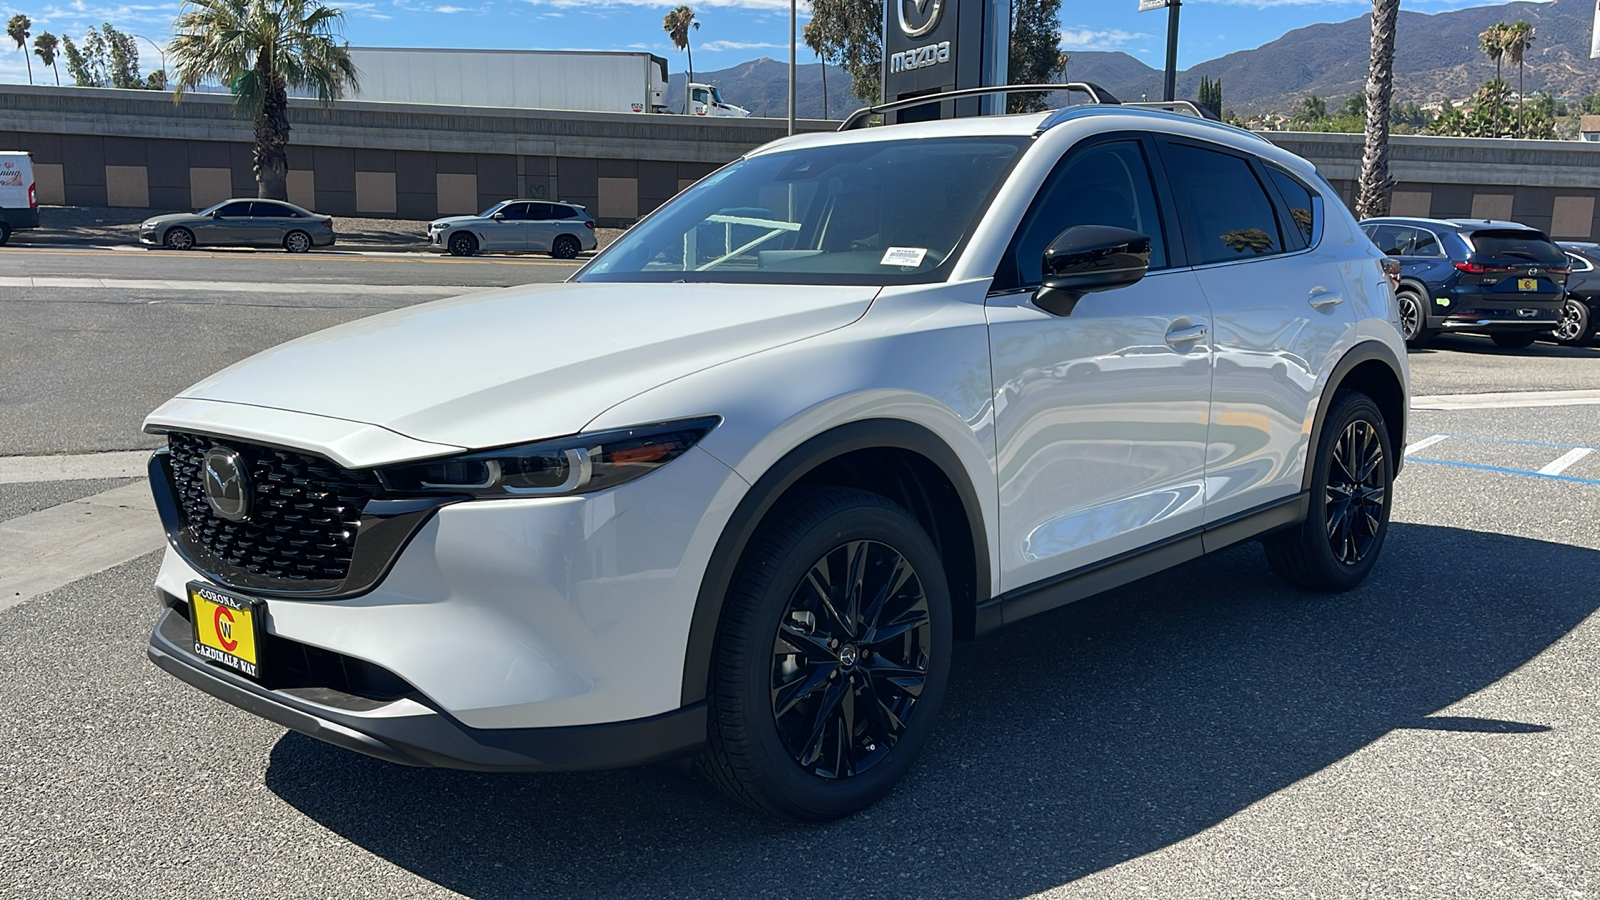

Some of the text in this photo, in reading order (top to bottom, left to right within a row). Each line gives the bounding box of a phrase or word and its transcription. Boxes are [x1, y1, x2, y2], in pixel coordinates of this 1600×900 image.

[891, 41, 951, 74] mazda
[200, 589, 237, 608] CORONA
[194, 643, 256, 677] CARDINALE WAY
